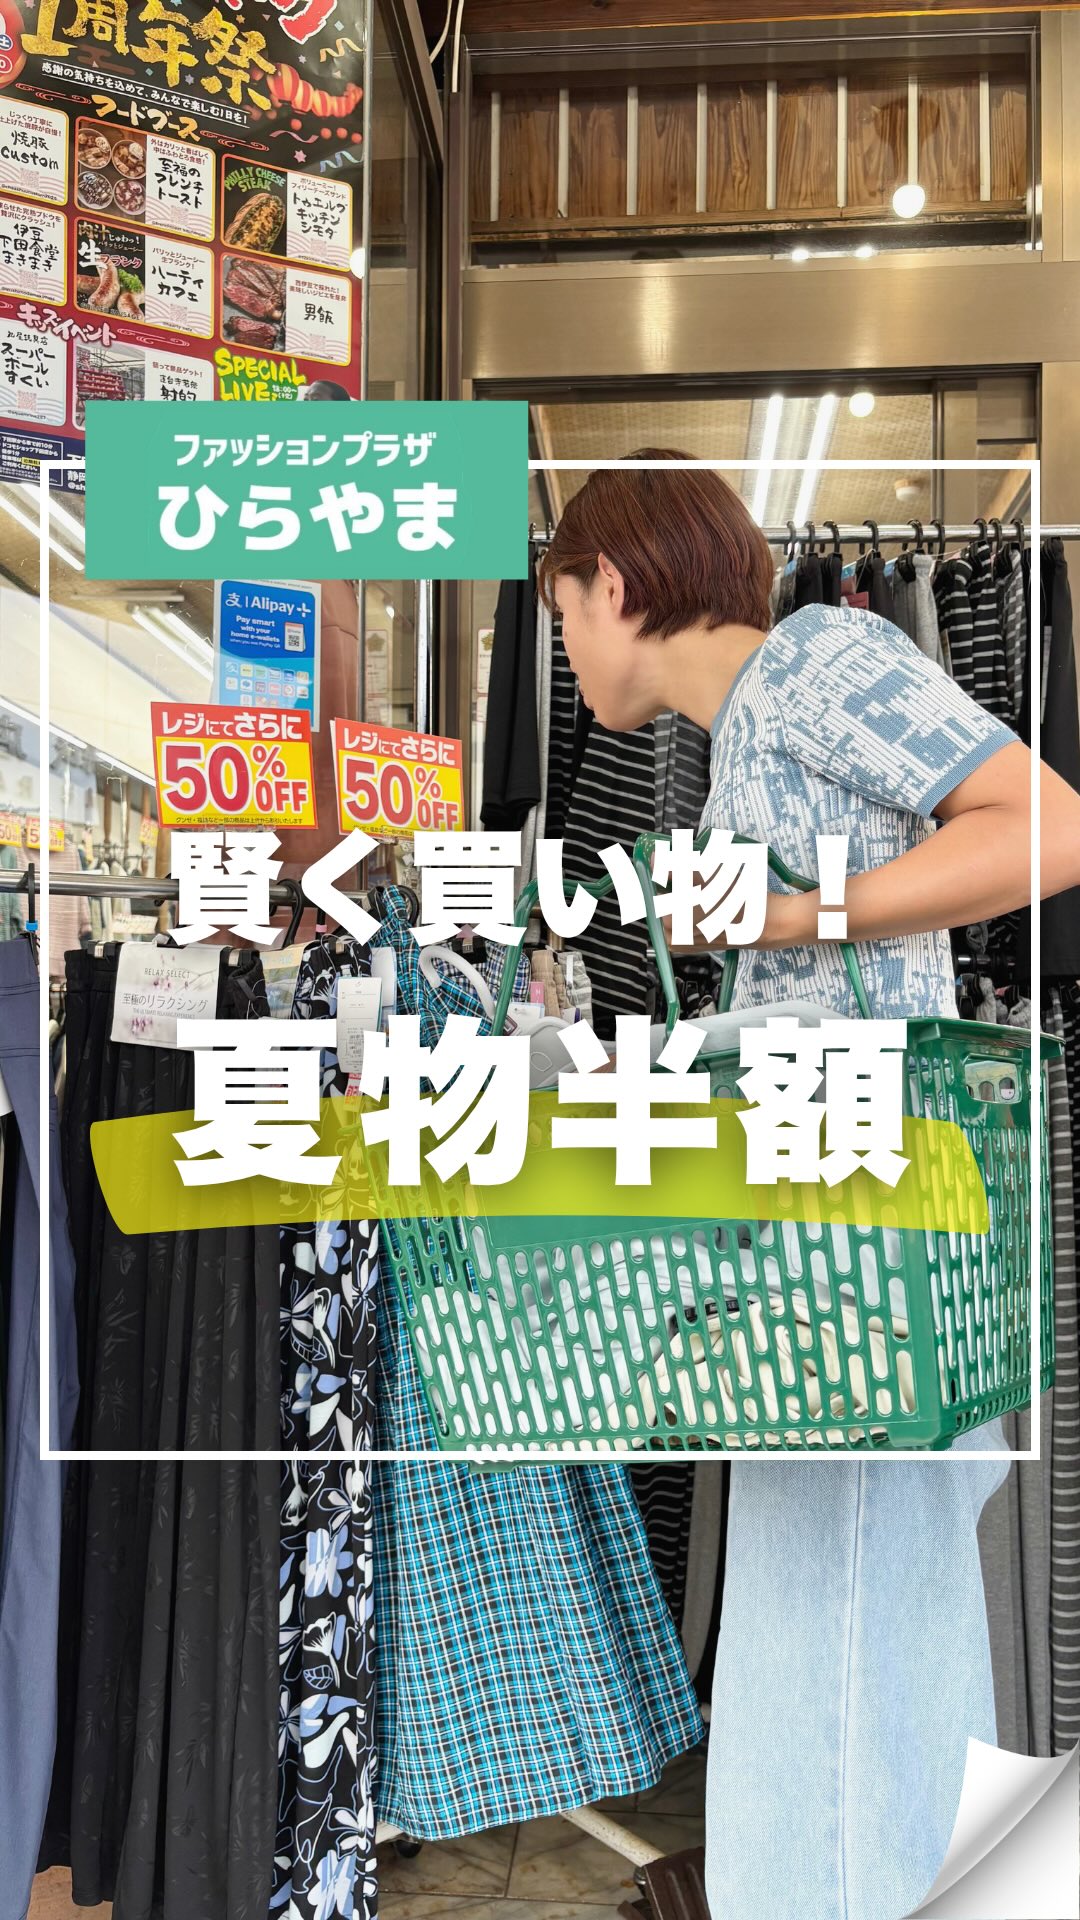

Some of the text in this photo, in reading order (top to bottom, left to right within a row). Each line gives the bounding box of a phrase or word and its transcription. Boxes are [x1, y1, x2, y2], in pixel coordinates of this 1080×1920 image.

[91, 94, 201, 142] フードブース
[11, 130, 50, 151] 焼豚
[158, 157, 201, 178] 至福の
[224, 167, 287, 191] PHILLY CHEESE
[154, 172, 205, 195] フレンチ
[238, 177, 272, 193] STEAK
[158, 186, 203, 210] トースト
[296, 207, 341, 226] キッチン
[13, 222, 45, 243] 伊豆
[2, 250, 53, 273] まきまき
[157, 281, 200, 303] カフェ
[16, 302, 118, 347] キッズイベント
[304, 302, 335, 326] 男飯
[0, 342, 57, 362] スーパー
[4, 370, 50, 389] すくい
[214, 349, 307, 387] SPECIAL
[236, 614, 276, 627] Pay smart
[162, 711, 303, 740] レジにてさらに
[343, 727, 456, 767] レジにてさらに
[255, 779, 308, 814] OFF
[415, 798, 459, 832] OFF
[144, 967, 191, 979] RELAX SELECT
